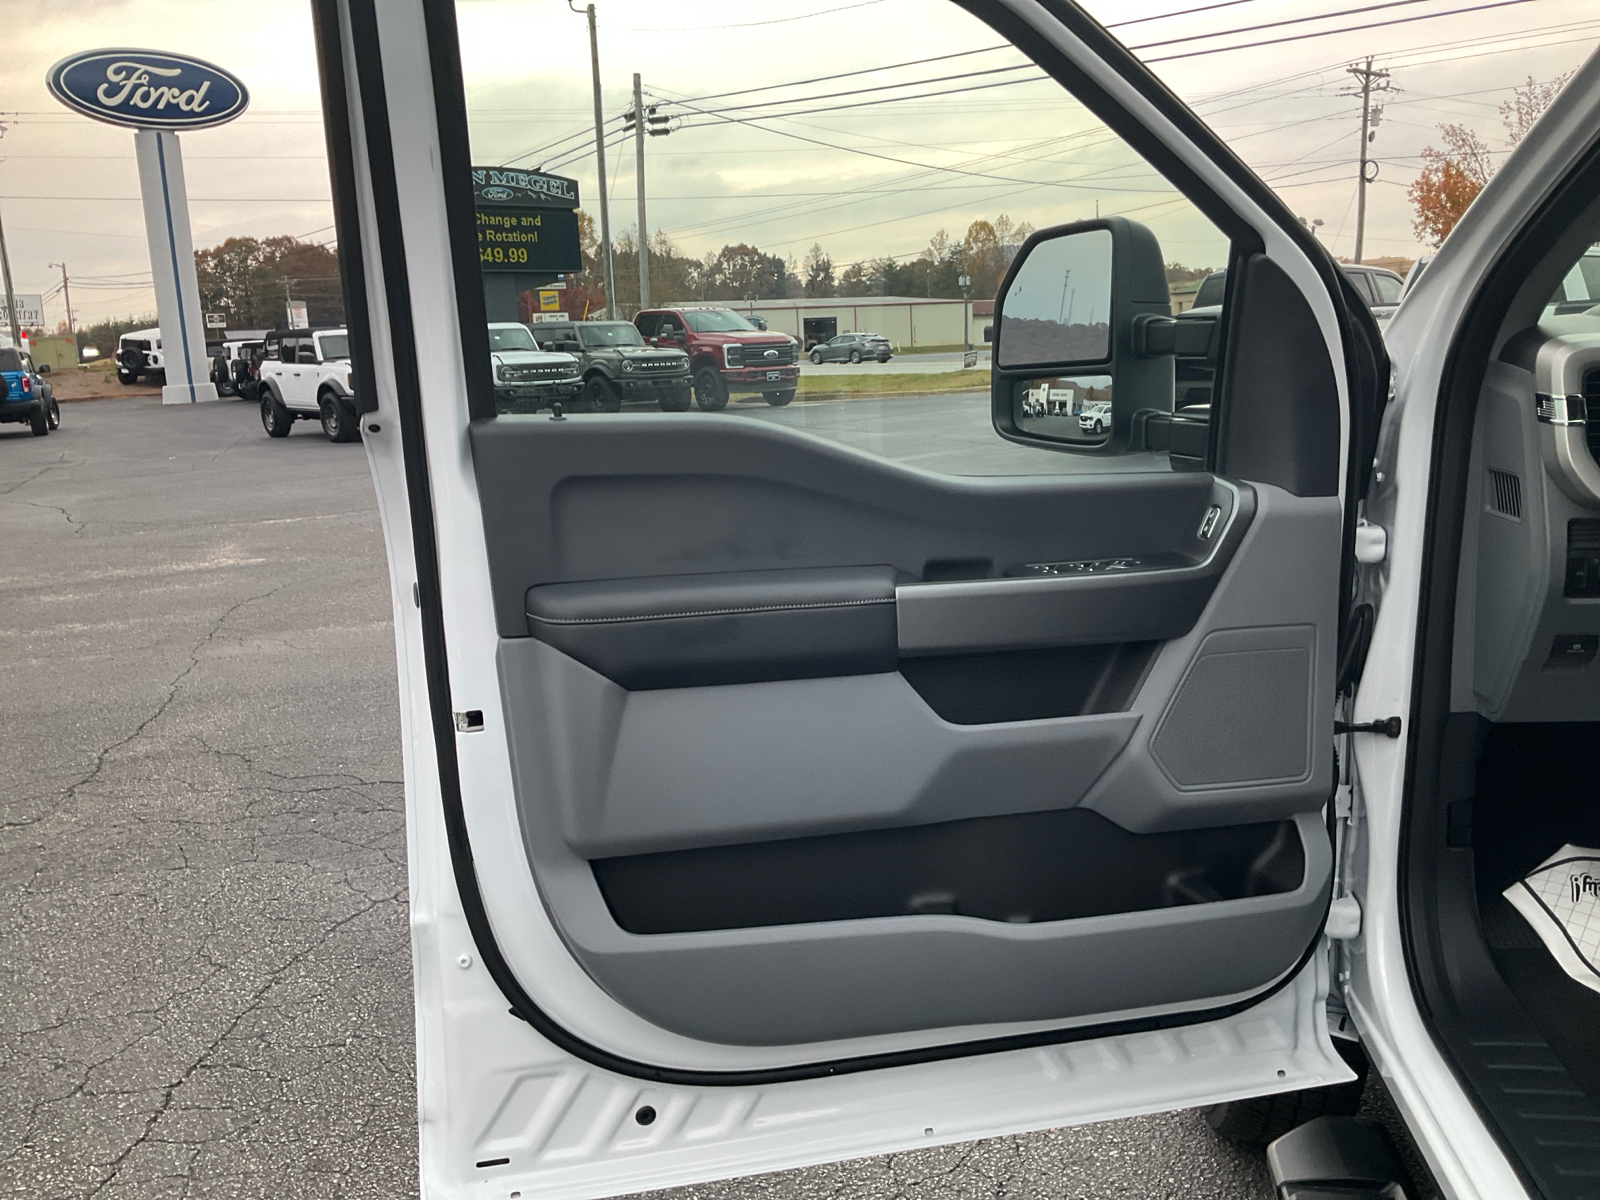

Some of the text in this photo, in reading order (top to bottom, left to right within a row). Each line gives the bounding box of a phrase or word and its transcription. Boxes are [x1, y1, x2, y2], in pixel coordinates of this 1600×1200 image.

[96, 61, 211, 113] Ford
[489, 170, 575, 200] MEGEL
[487, 188, 508, 199] Ford
[520, 214, 542, 227] and
[486, 230, 538, 243] Rotation!
